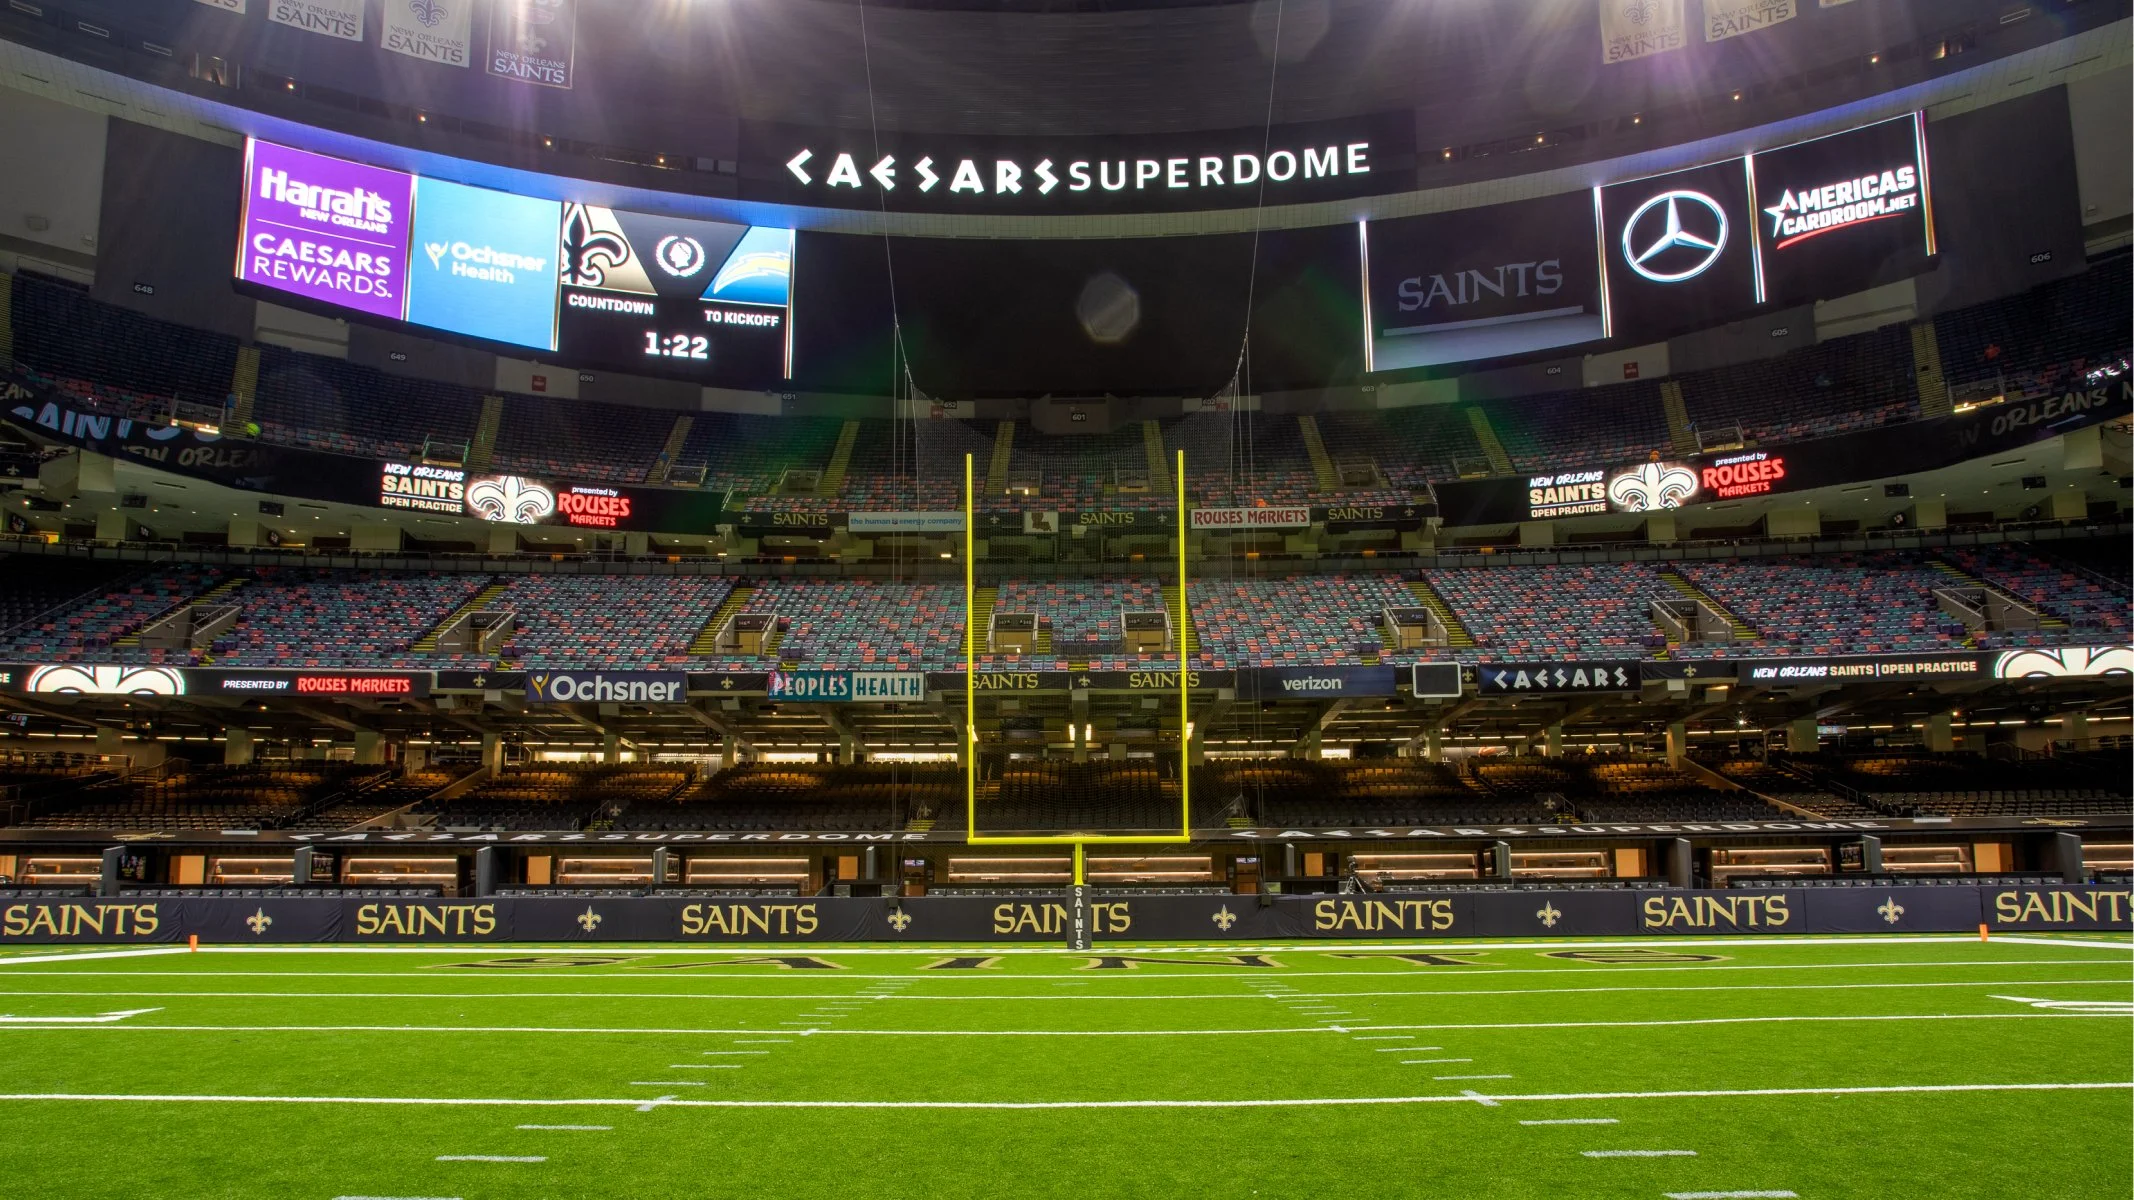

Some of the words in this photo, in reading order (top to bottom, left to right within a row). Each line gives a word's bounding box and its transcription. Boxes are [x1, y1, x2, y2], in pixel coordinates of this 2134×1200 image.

[276, 6, 356, 37] SAINTS
[308, 5, 357, 22] ORLEANS
[1711, 5, 1789, 38] SAINTS
[390, 25, 415, 36] NEW
[418, 32, 464, 48] ORLEANS
[1608, 33, 1680, 60] SAINTS
[388, 34, 463, 63] SAINTS
[496, 50, 519, 60] NEW
[522, 56, 565, 69] ORLEANS
[494, 58, 565, 84] SAINTS
[786, 147, 1060, 194] CAESARS
[1068, 142, 1371, 192] SUPERDOME
[1763, 166, 1917, 218] AMERICAS
[300, 209, 329, 223] NEW
[332, 215, 388, 234] ORLEANS
[1782, 193, 1917, 235] CARDROOM.NET
[253, 233, 391, 276] CAESARS
[451, 241, 547, 273] Ochsner
[2031, 253, 2051, 263] 606
[451, 262, 515, 284] Health
[134, 284, 153, 294] 648
[1397, 258, 1563, 312] SAINTS
[568, 294, 654, 315] COUNTDOWN
[704, 309, 722, 323] TO
[724, 311, 780, 327] KICKOFF
[1771, 327, 1788, 337] 605
[644, 331, 709, 359] 1:22
[580, 374, 594, 382] 650
[1547, 367, 1561, 375] 604
[782, 393, 796, 401] 651
[1071, 413, 1086, 421] 601
[1991, 387, 2108, 436] ORLEANS
[1715, 453, 1752, 467] presented
[1753, 452, 1767, 462] by
[384, 462, 410, 475] NEW
[413, 466, 464, 482] ORLEANS
[1529, 476, 1554, 488] NEW
[1556, 470, 1603, 485] ORLEANS
[1703, 458, 1785, 488] ROUSES
[381, 475, 464, 500] SAINTS
[571, 486, 602, 496] presented
[604, 487, 618, 498] by
[1529, 482, 1605, 505] SAINTS
[1718, 481, 1770, 497] MARKETS
[381, 496, 410, 508] OPEN
[411, 499, 463, 513] PRACTICE
[558, 493, 630, 517] ROUSES
[1328, 507, 1383, 520] SAINTS
[1531, 507, 1557, 518] OPEN
[1558, 502, 1606, 515] PRACTICE
[571, 513, 616, 527] MARKETS
[773, 512, 828, 526] SAINTS
[850, 517, 864, 526] the
[928, 517, 962, 528] company
[1080, 512, 1135, 525] SAINTS
[1194, 510, 1243, 525] ROUSES
[1247, 509, 1307, 524] MARKETS
[1494, 667, 1628, 689] CAESARS
[1753, 667, 1778, 679] NEW
[1780, 666, 1827, 677] ORLEANS
[1830, 664, 1874, 676] SAINTS
[1881, 664, 1914, 676] OPEN
[1916, 661, 1977, 674] PRACTICE
[223, 679, 267, 690] PRESENTED
[270, 680, 288, 690] BY
[297, 676, 347, 693] ROUSES
[350, 677, 409, 693] MARKETS
[550, 674, 680, 701] Ochsner
[773, 676, 848, 696] PEOPLES
[856, 677, 920, 696] HEALTH
[971, 673, 1038, 689] SAINTS
[1129, 672, 1199, 689] SAINTS
[1282, 675, 1342, 692] verizon
[598, 832, 928, 842] SUPERDOME
[1537, 820, 1889, 835] SUPERDOME
[1314, 898, 1454, 931] SAINTS
[1644, 894, 1790, 928] SAINTS
[1996, 891, 2133, 923] SAINT
[3, 903, 159, 936] SAINTS
[356, 903, 497, 936] SAINTS
[682, 903, 818, 935] SAINTS
[993, 901, 1130, 935] SAINTS
[1074, 886, 1084, 950] SAINTS
